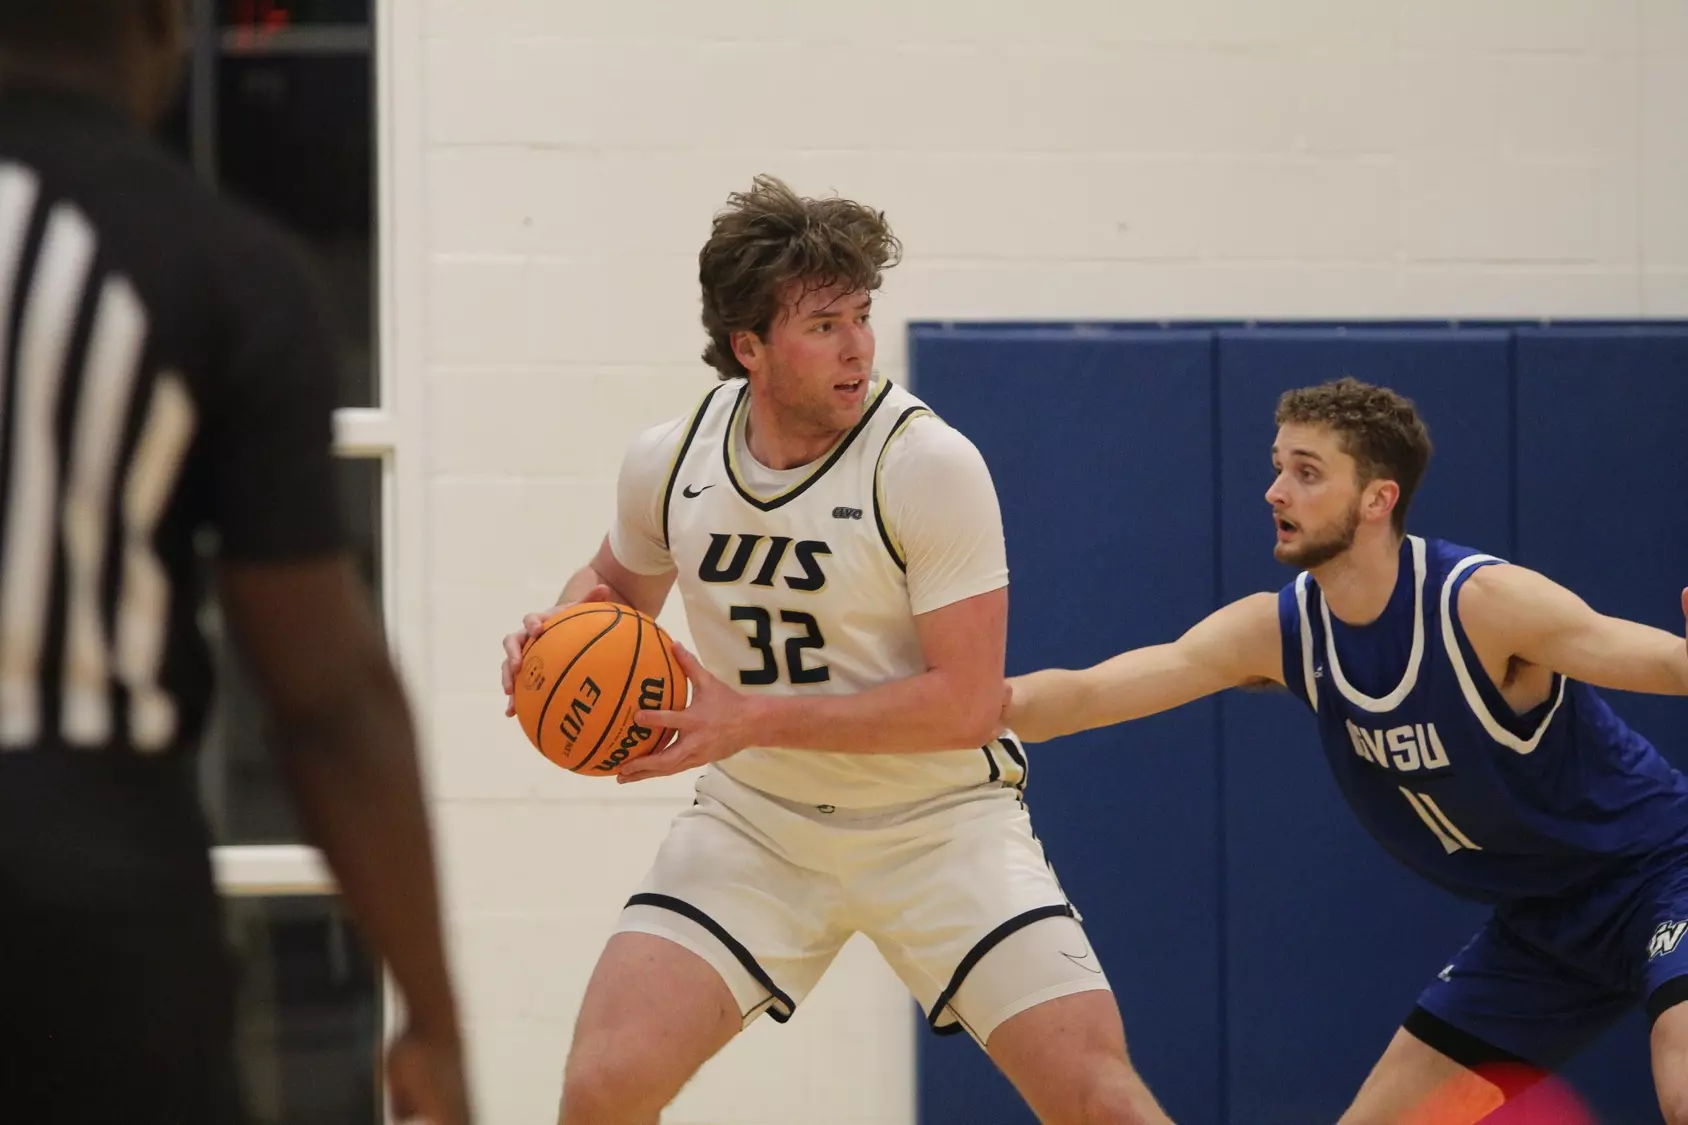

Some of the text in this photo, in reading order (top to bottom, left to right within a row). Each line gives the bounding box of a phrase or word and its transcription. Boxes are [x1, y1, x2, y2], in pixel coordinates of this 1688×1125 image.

[698, 532, 833, 592] UIS
[730, 605, 830, 685] 32
[559, 676, 602, 743] EVO
[594, 677, 665, 771] Wlson
[1398, 785, 1483, 855] 11
